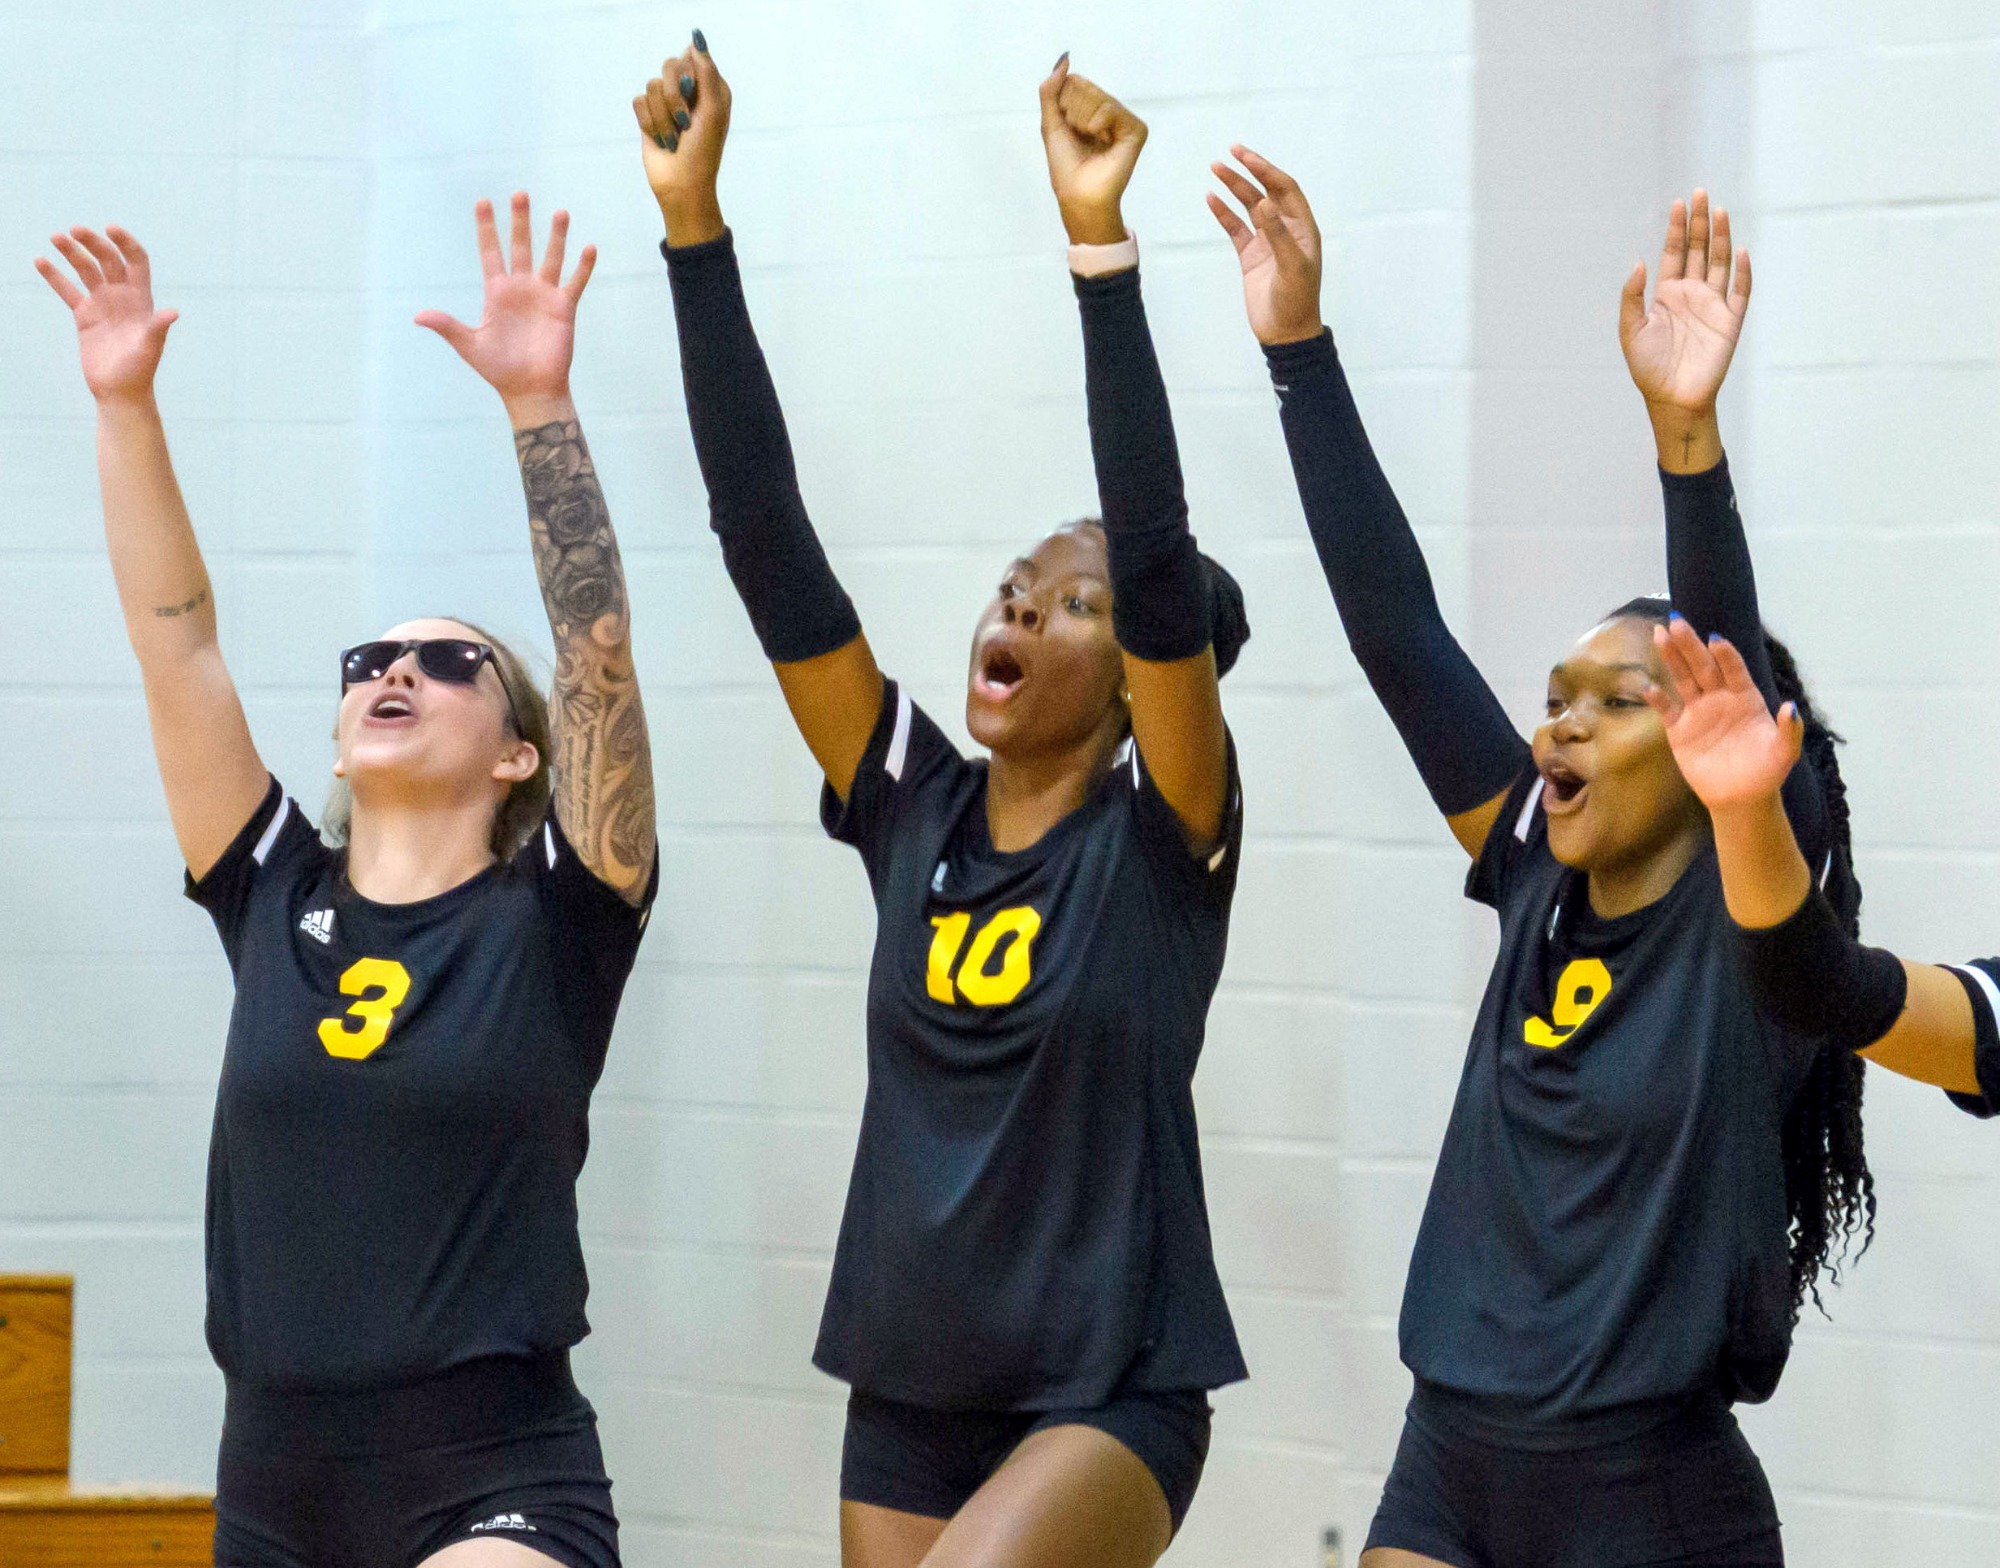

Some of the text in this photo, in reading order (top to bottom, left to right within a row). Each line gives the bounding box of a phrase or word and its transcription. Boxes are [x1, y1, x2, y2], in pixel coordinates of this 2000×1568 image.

[299, 916, 331, 944] didas
[926, 905, 1041, 1007] 10
[317, 957, 411, 1060] 3
[1524, 957, 1613, 1048] 9
